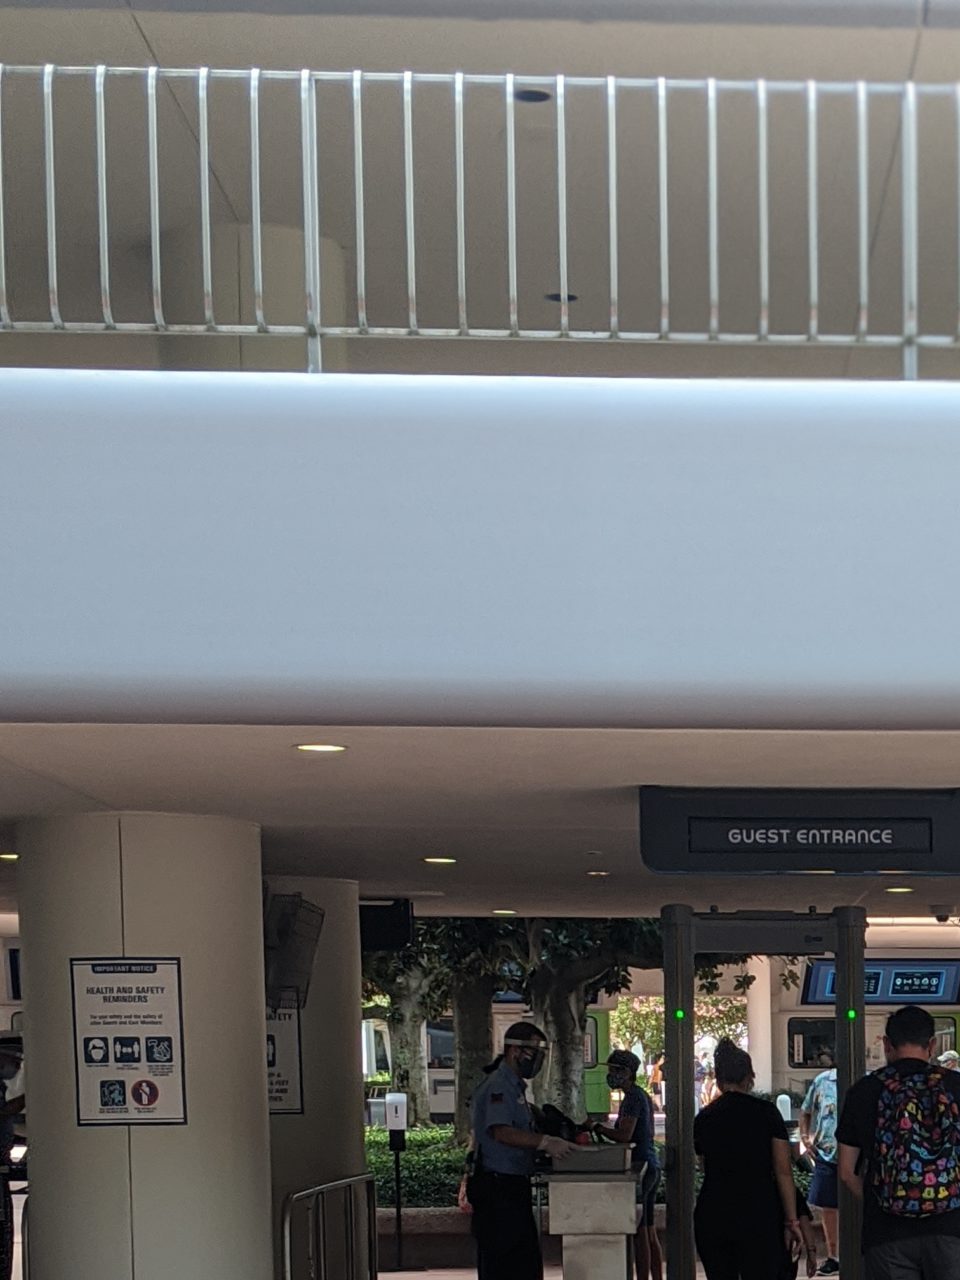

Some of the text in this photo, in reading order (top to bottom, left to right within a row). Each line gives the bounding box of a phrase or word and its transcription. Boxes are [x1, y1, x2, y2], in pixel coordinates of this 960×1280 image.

[728, 829, 893, 844] GUEST ENTRANCE
[86, 987, 114, 995] HEALTH
[135, 986, 166, 994] SAFETY
[102, 995, 148, 1003] REMINDERS
